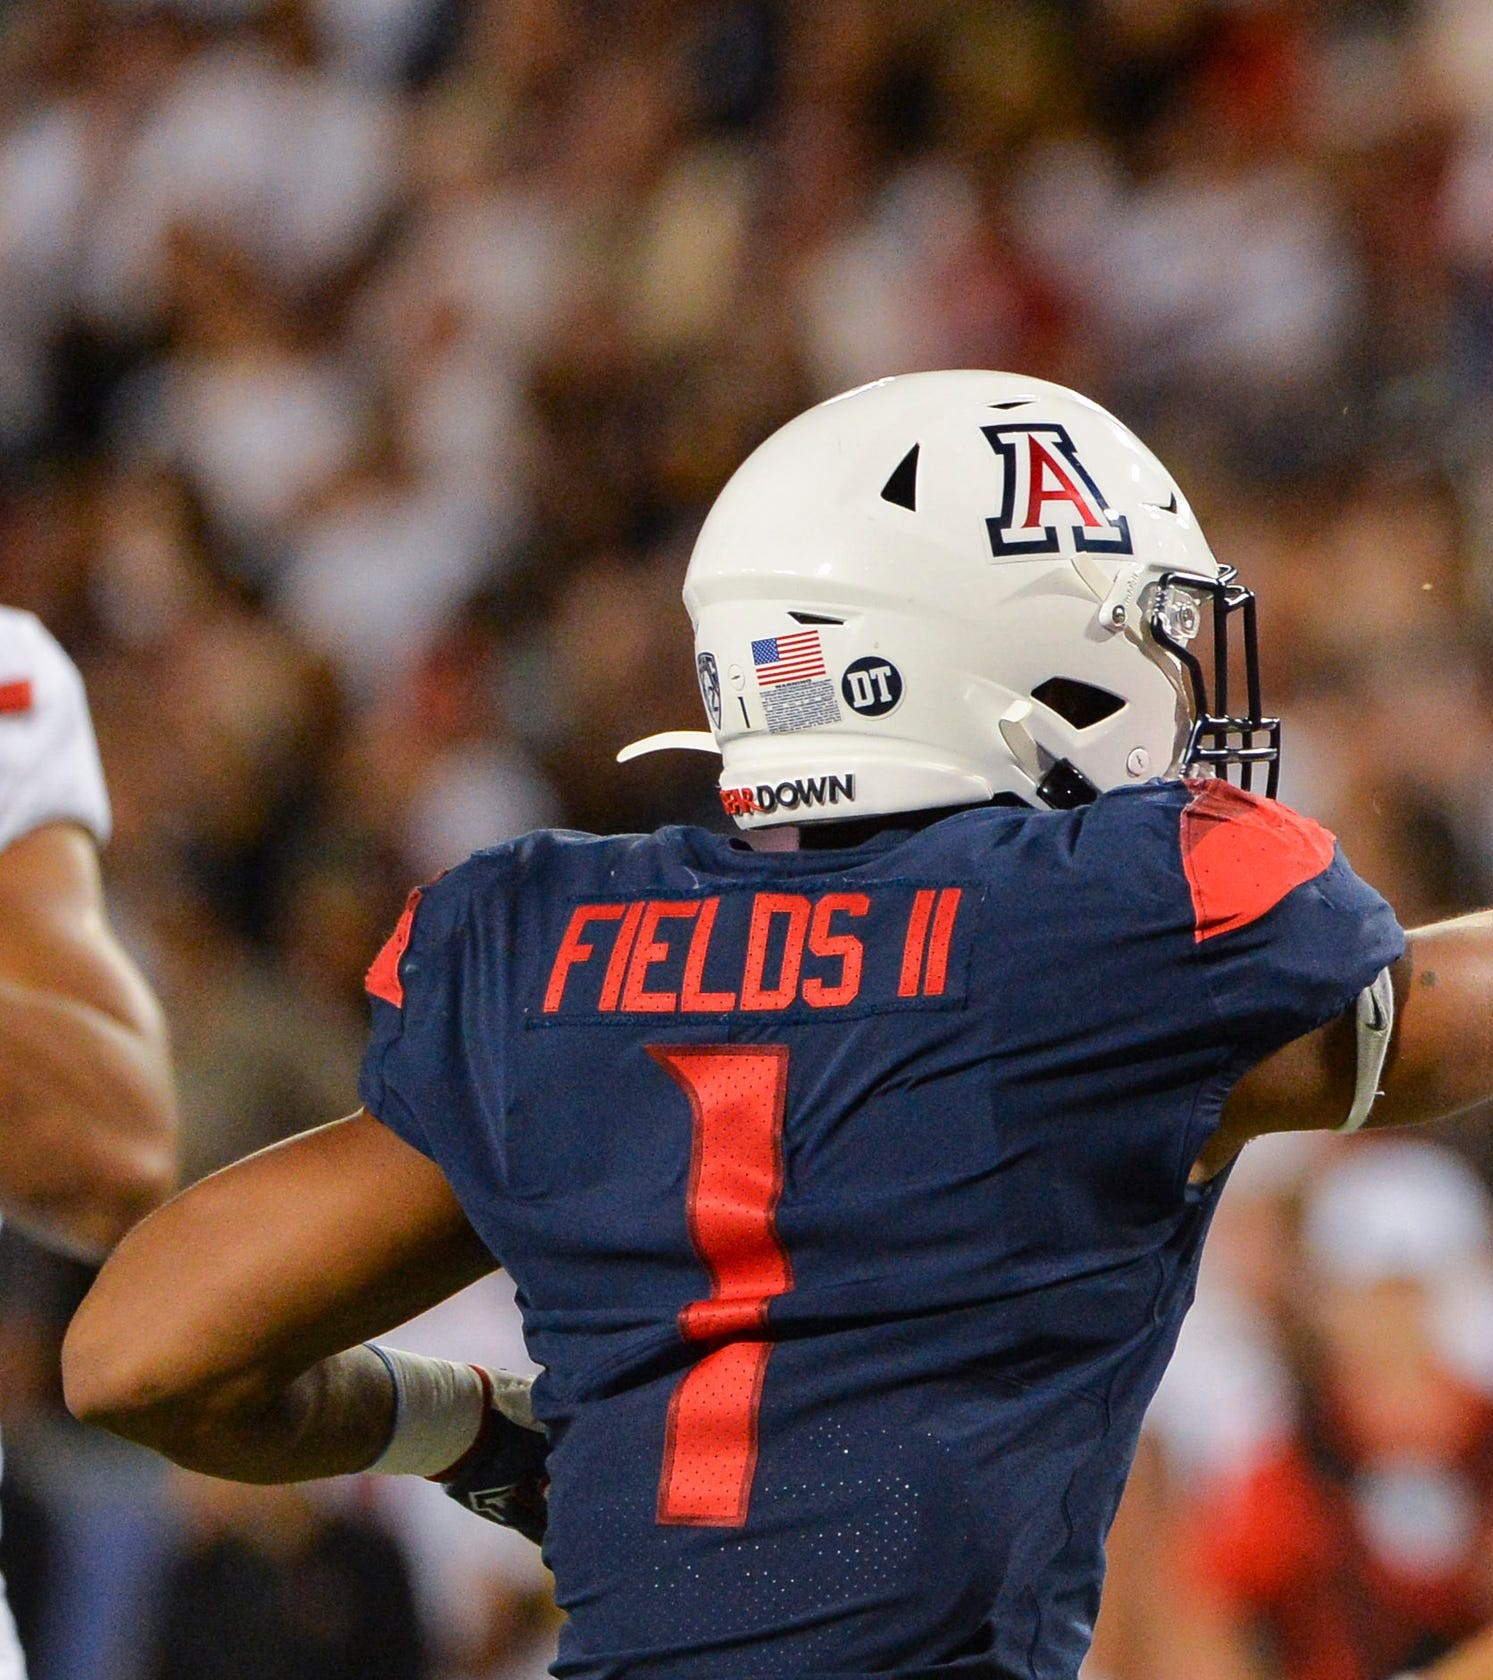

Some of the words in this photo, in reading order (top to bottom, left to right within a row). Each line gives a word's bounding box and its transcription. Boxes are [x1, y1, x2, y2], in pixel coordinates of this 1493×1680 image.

[981, 423, 1133, 557] A
[847, 665, 893, 708] DT
[756, 773, 856, 811] DOWN
[543, 892, 870, 1013] FIELDS
[897, 887, 962, 997] II
[645, 1043, 793, 1527] 1
